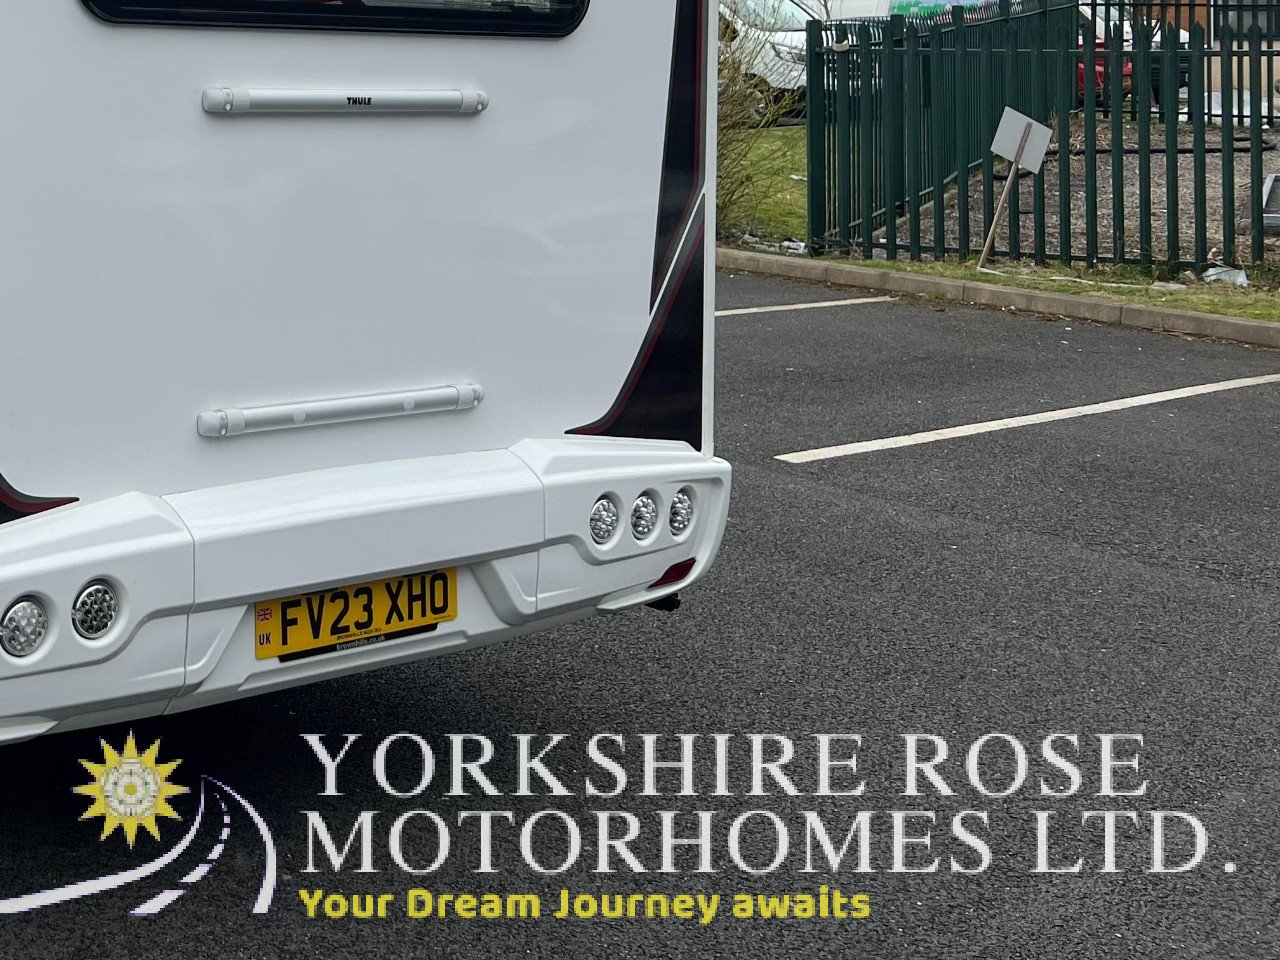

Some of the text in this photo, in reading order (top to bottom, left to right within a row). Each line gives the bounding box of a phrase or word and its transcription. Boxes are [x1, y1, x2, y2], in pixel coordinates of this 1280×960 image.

[346, 97, 372, 106] THULE
[280, 572, 449, 646] FV23 XHO
[258, 632, 272, 646] UK
[336, 634, 386, 651] brownhills.co.uk
